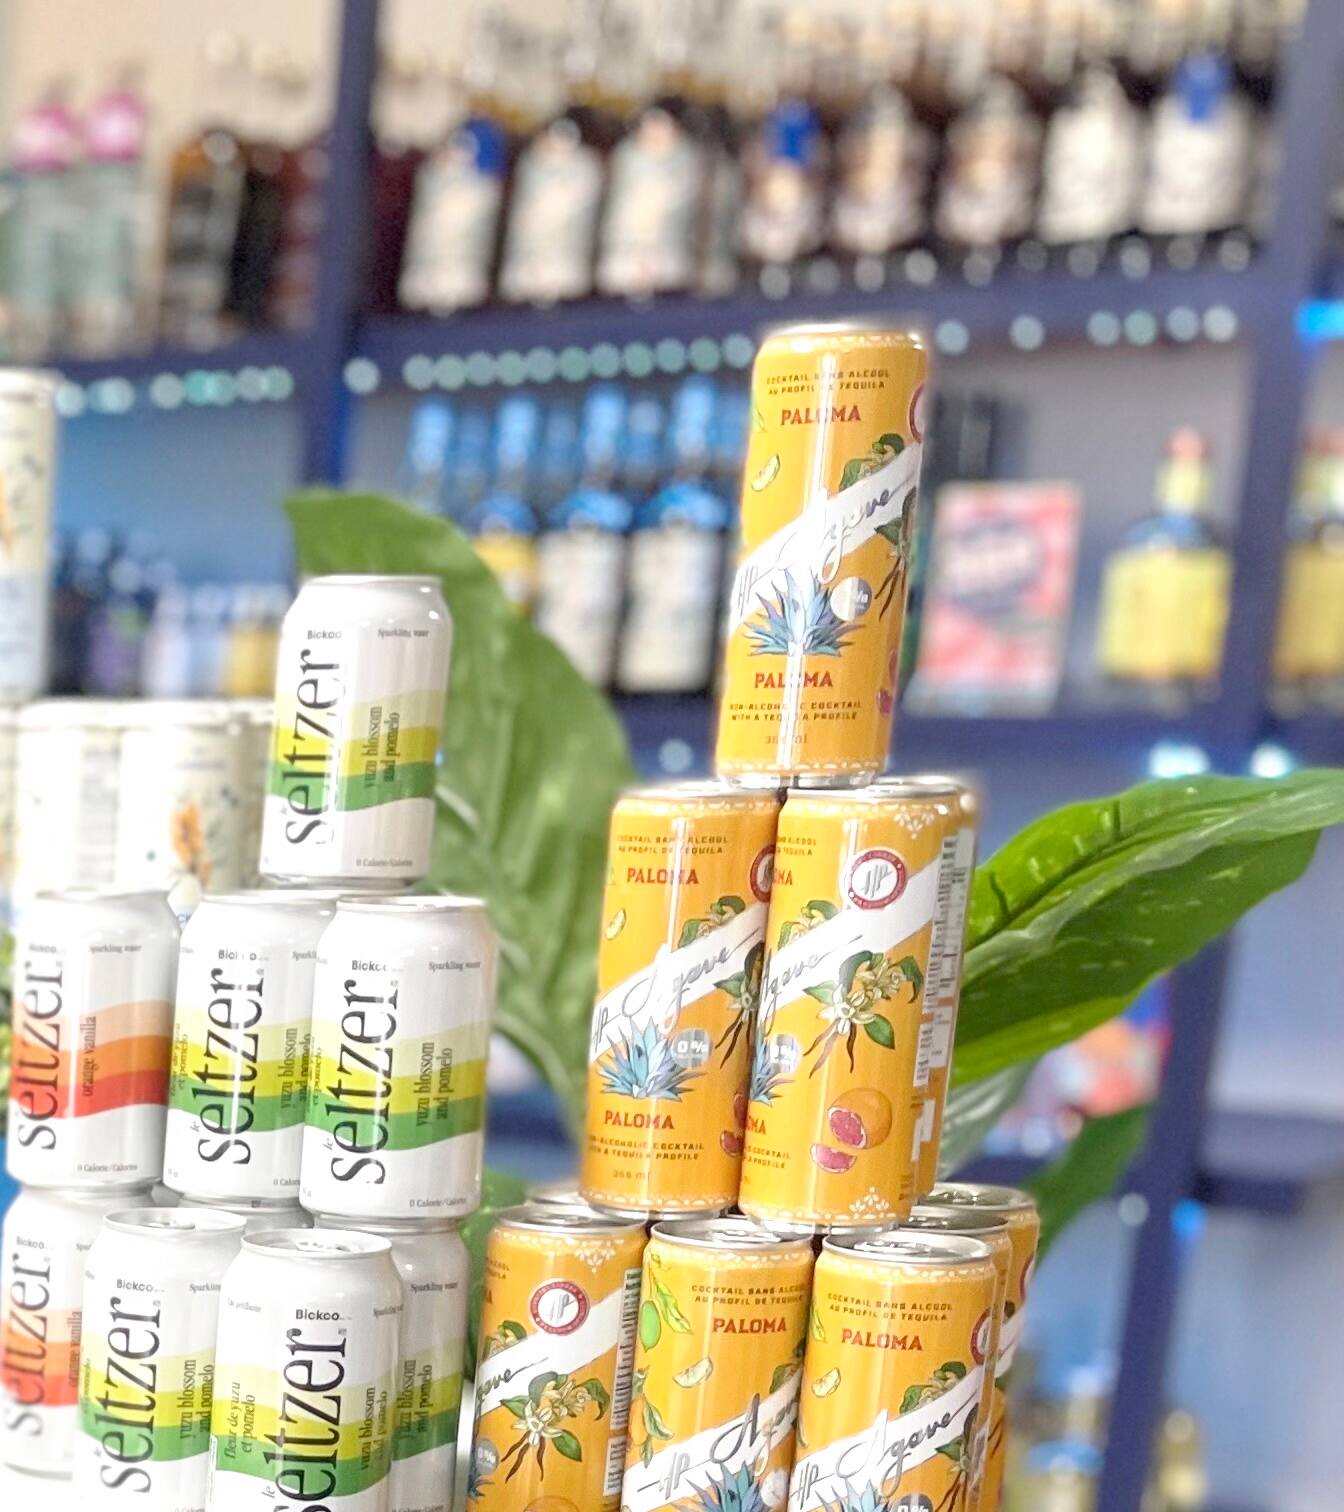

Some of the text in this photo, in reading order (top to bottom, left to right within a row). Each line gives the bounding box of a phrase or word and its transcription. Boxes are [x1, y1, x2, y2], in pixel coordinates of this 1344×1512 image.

[781, 405, 861, 426] PALMA
[755, 672, 832, 688] PALMA
[14, 961, 63, 1150] seltzer
[192, 968, 264, 1165] seltzer
[414, 1042, 434, 1094] blossom
[435, 1047, 453, 1093] pomelo
[325, 979, 398, 1185] seltzer
[604, 1110, 674, 1130] PALOMA
[691, 1285, 775, 1296] COCKTAIL SANS
[828, 1293, 952, 1311] COCKTAIL SANS ALCOOL
[712, 1318, 787, 1334] PALOMA
[901, 1313, 947, 1321] TEQUILA
[841, 1328, 923, 1351] PALOMA
[95, 1297, 160, 1493] seltzer
[177, 1360, 196, 1408] blossom
[836, 1390, 978, 1500] Agave
